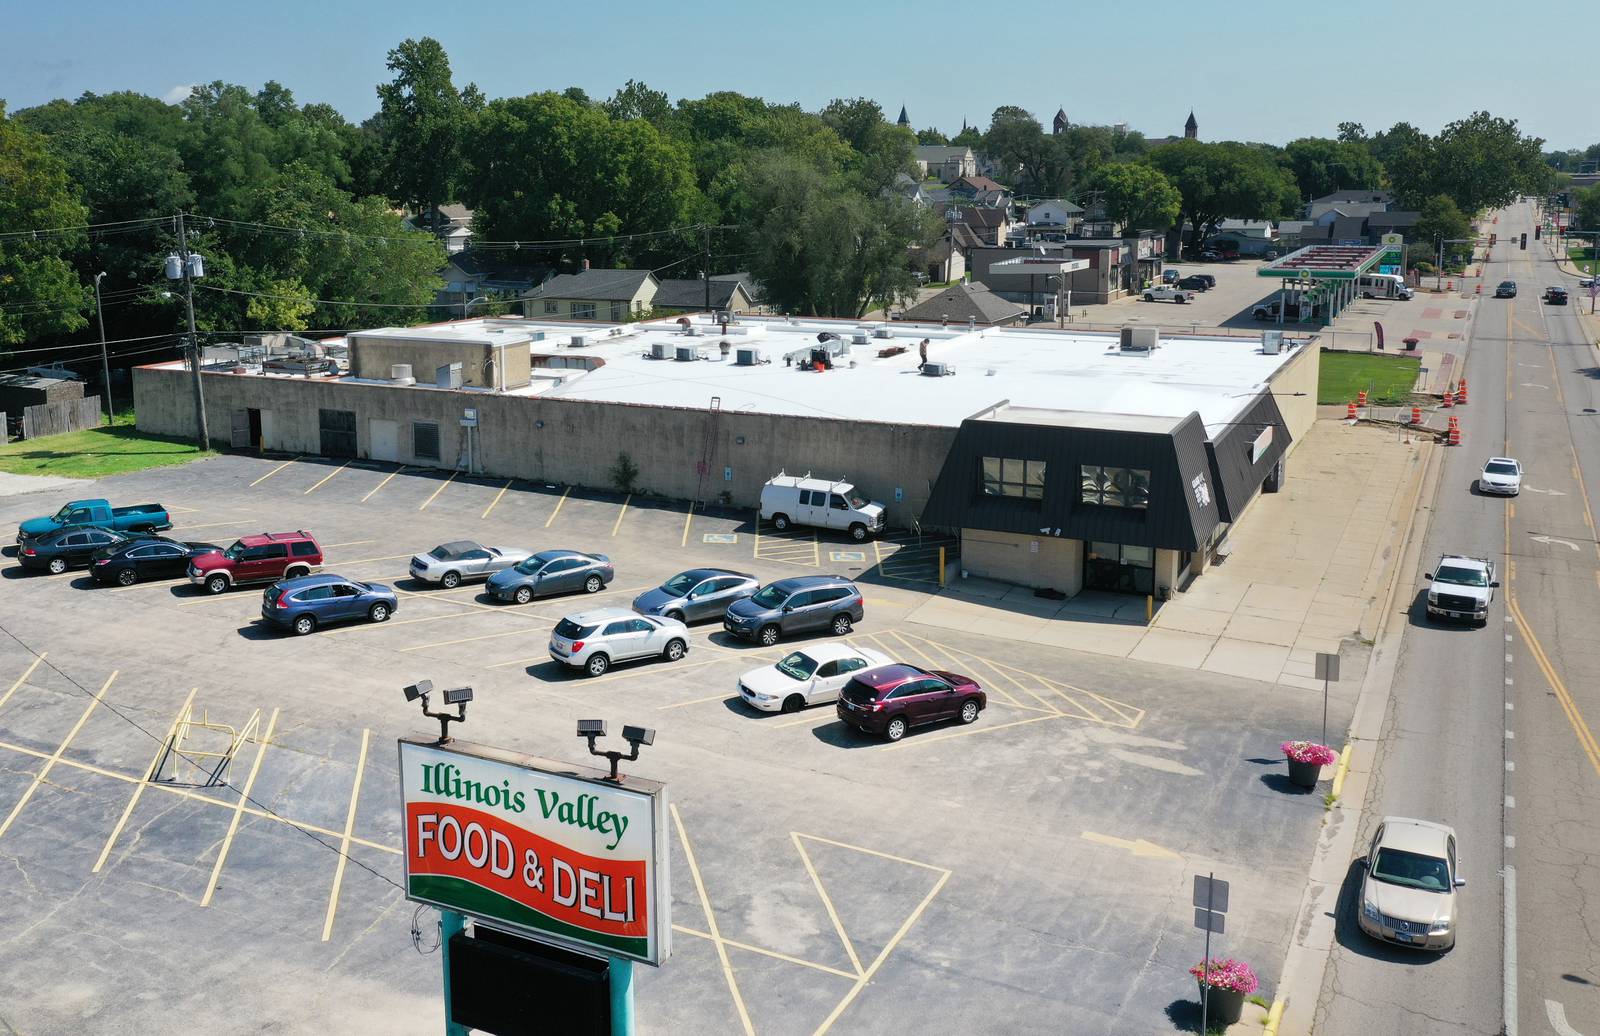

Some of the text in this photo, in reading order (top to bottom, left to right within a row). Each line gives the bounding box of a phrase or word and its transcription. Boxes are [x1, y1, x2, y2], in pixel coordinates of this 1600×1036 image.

[420, 762, 629, 850] Illinois Valley
[416, 813, 636, 923] FOOD & DELI
